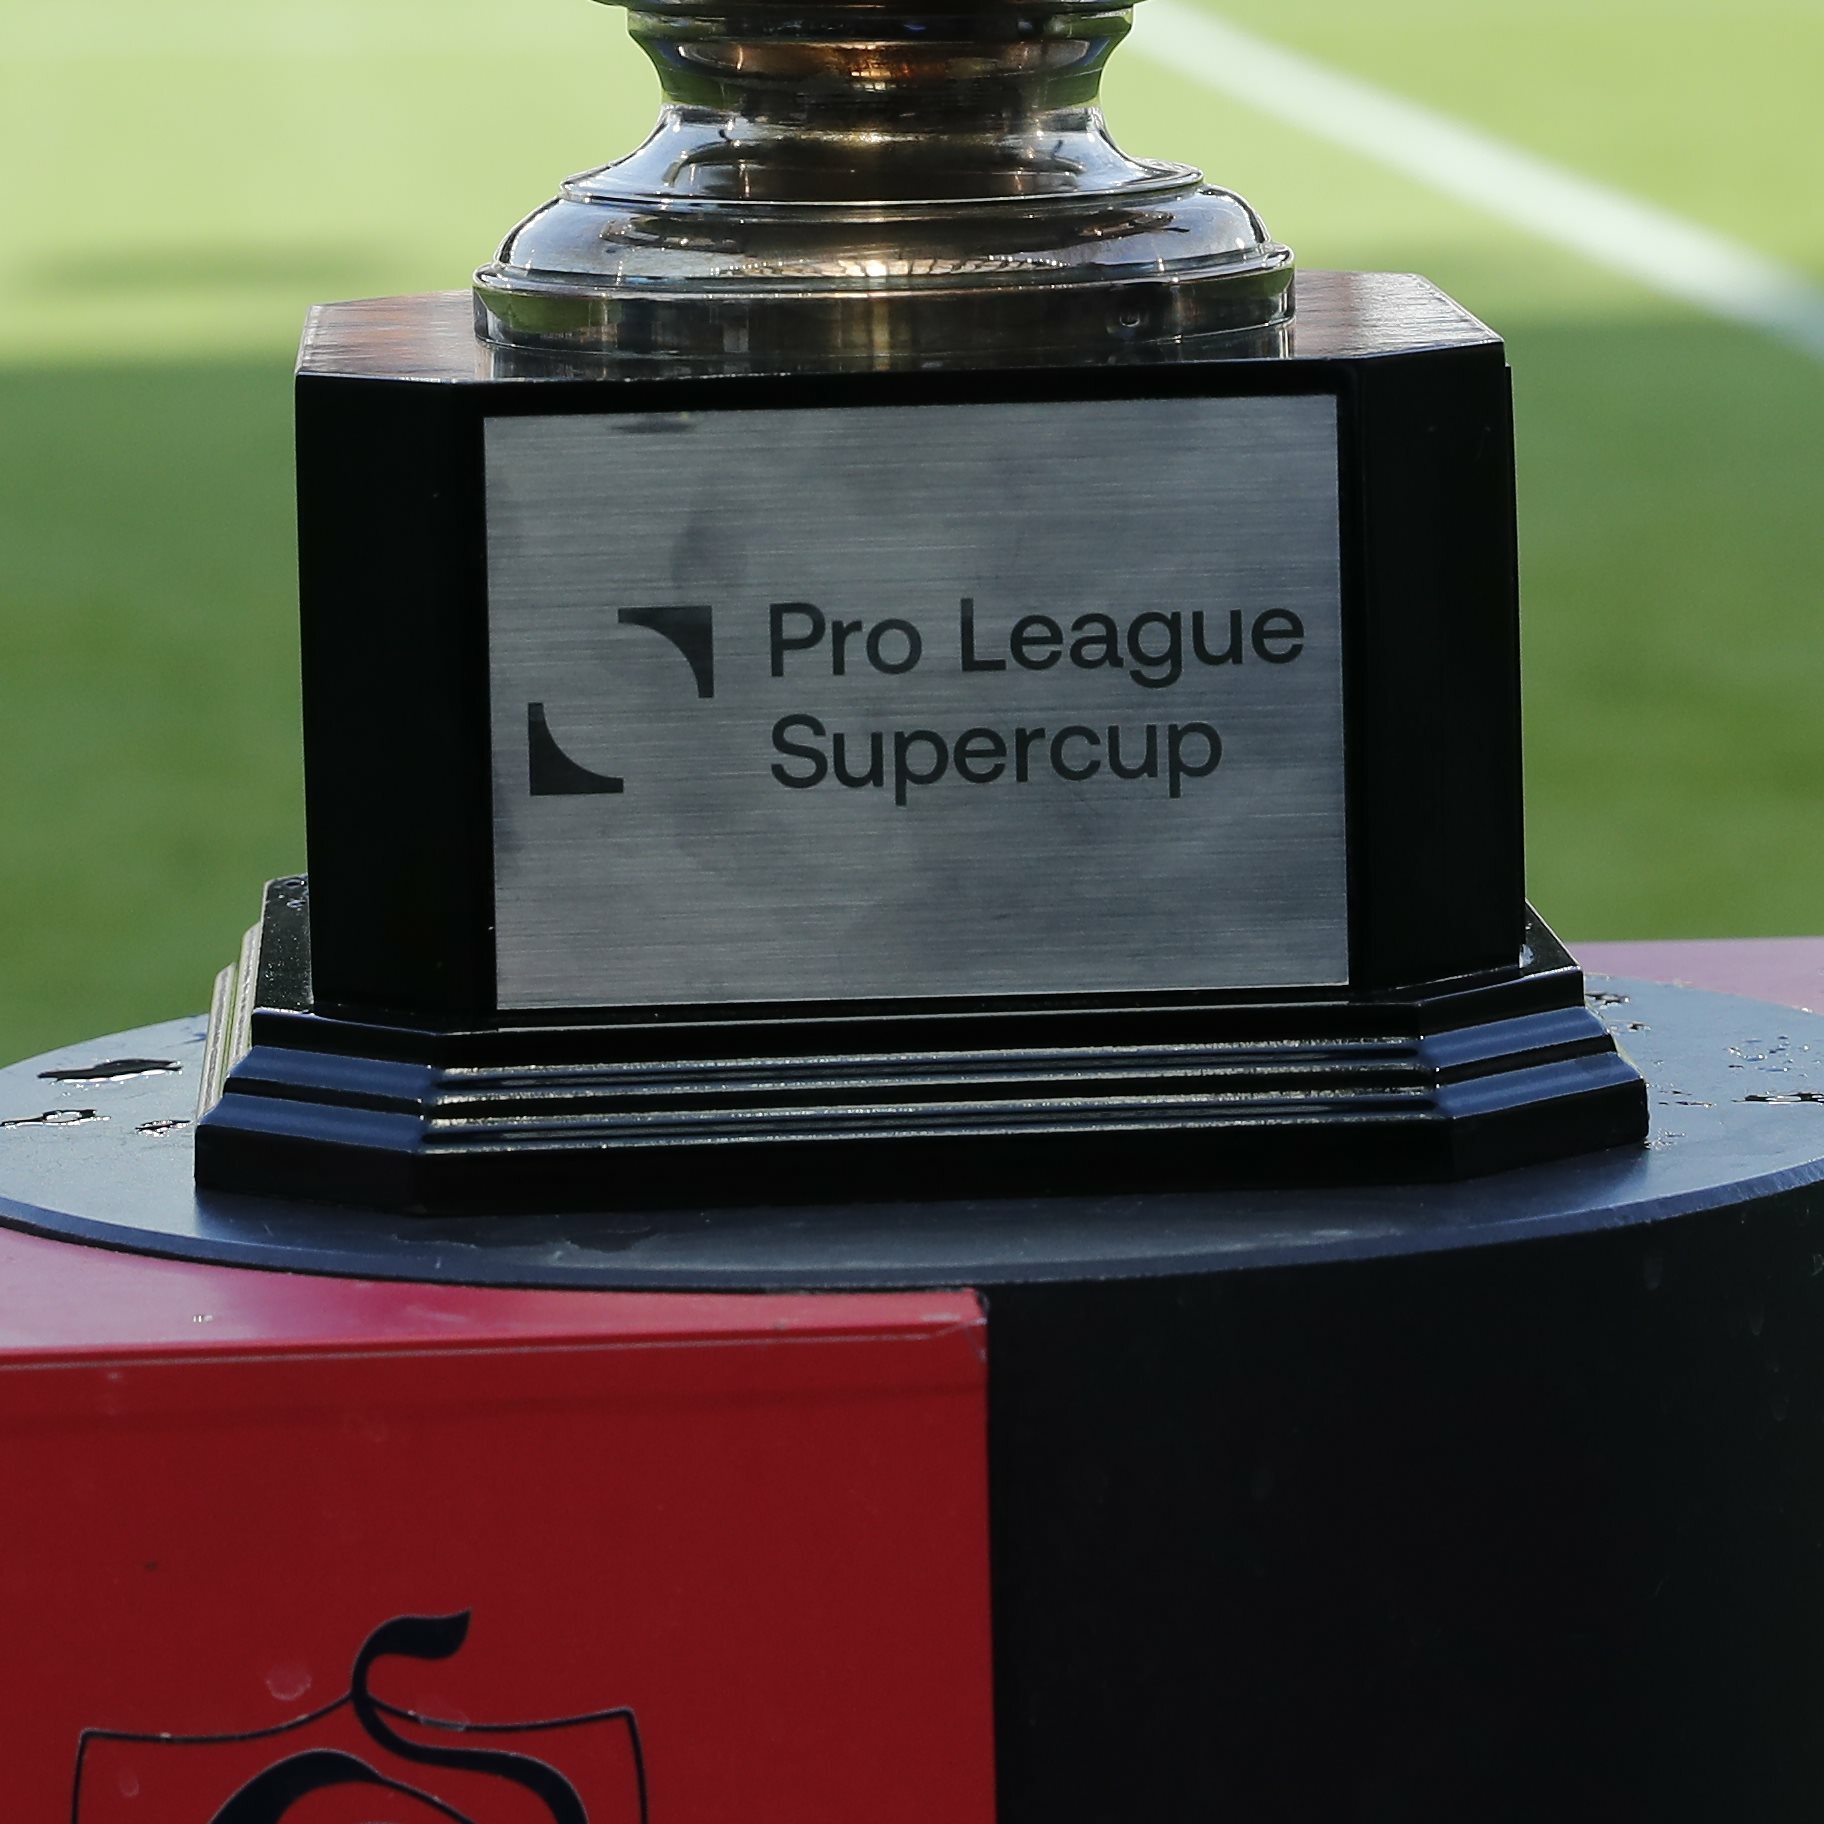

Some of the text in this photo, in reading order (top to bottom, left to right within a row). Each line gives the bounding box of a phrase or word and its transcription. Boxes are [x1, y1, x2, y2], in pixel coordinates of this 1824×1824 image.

[769, 597, 1306, 689] Pro League
[770, 713, 1223, 807] Supercup
